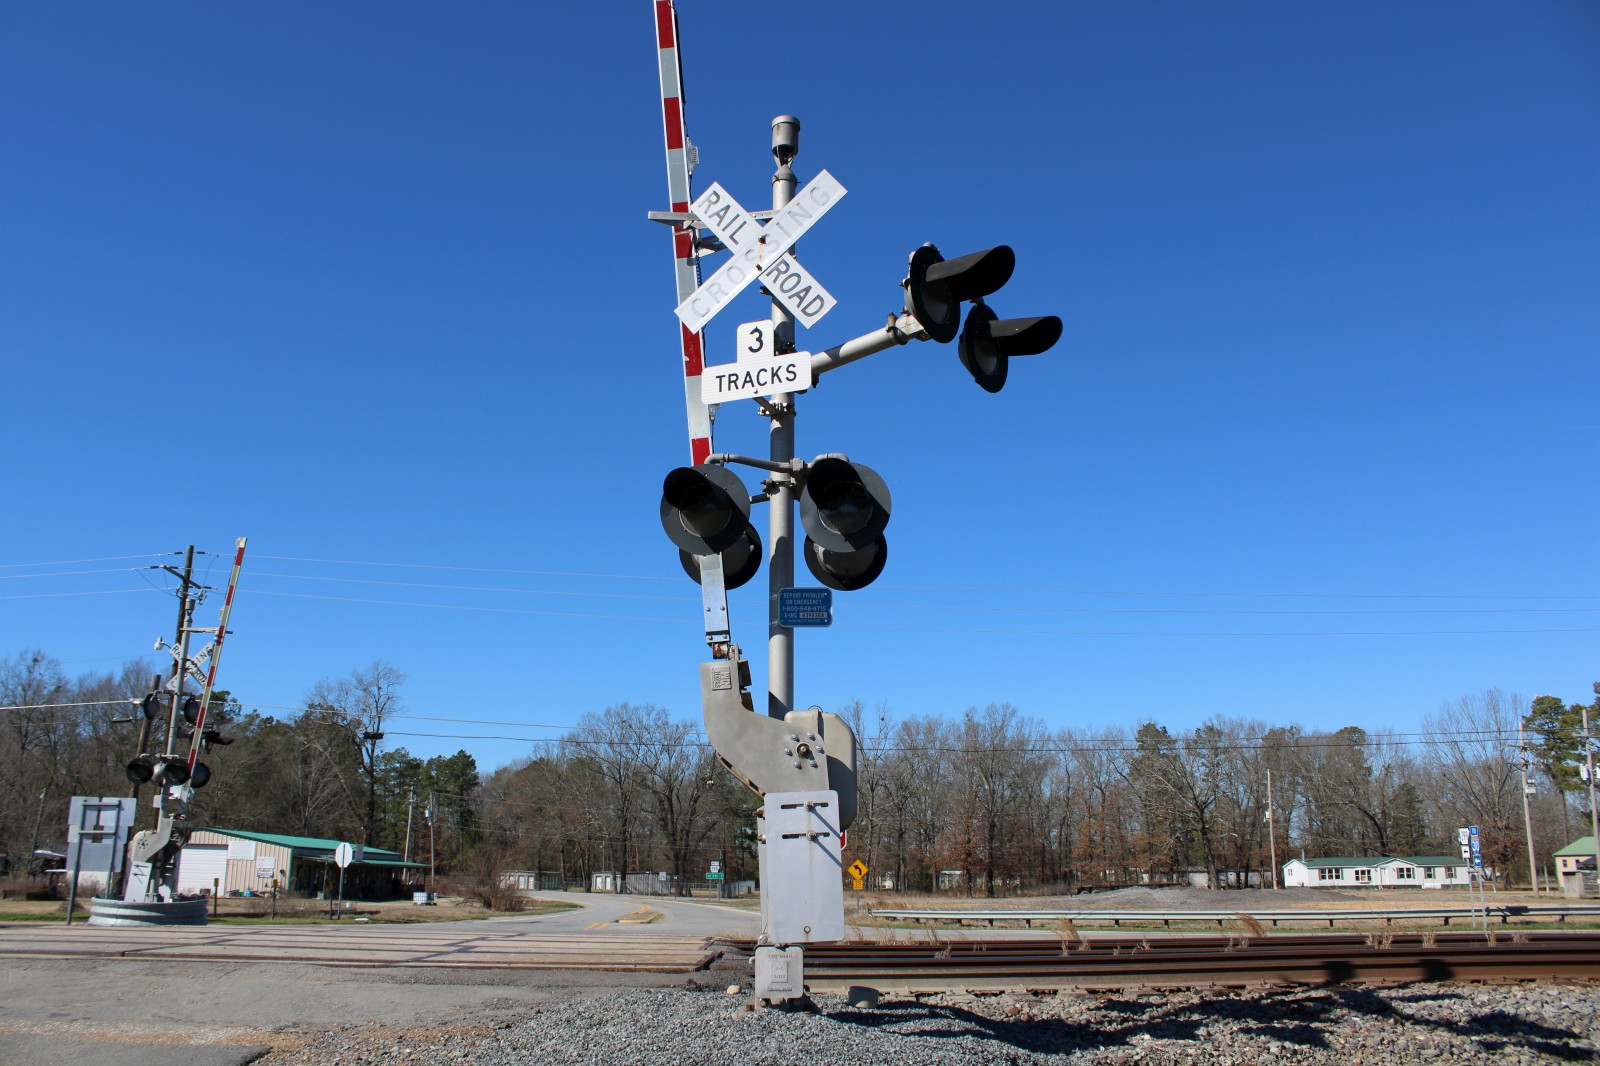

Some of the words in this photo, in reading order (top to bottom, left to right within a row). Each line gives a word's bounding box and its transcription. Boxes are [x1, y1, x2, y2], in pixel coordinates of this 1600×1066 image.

[691, 186, 831, 318] CROSSING
[698, 190, 747, 245] RAIL
[766, 259, 825, 318] ROAD
[715, 364, 797, 392] TRACKS
[748, 326, 764, 353] 3
